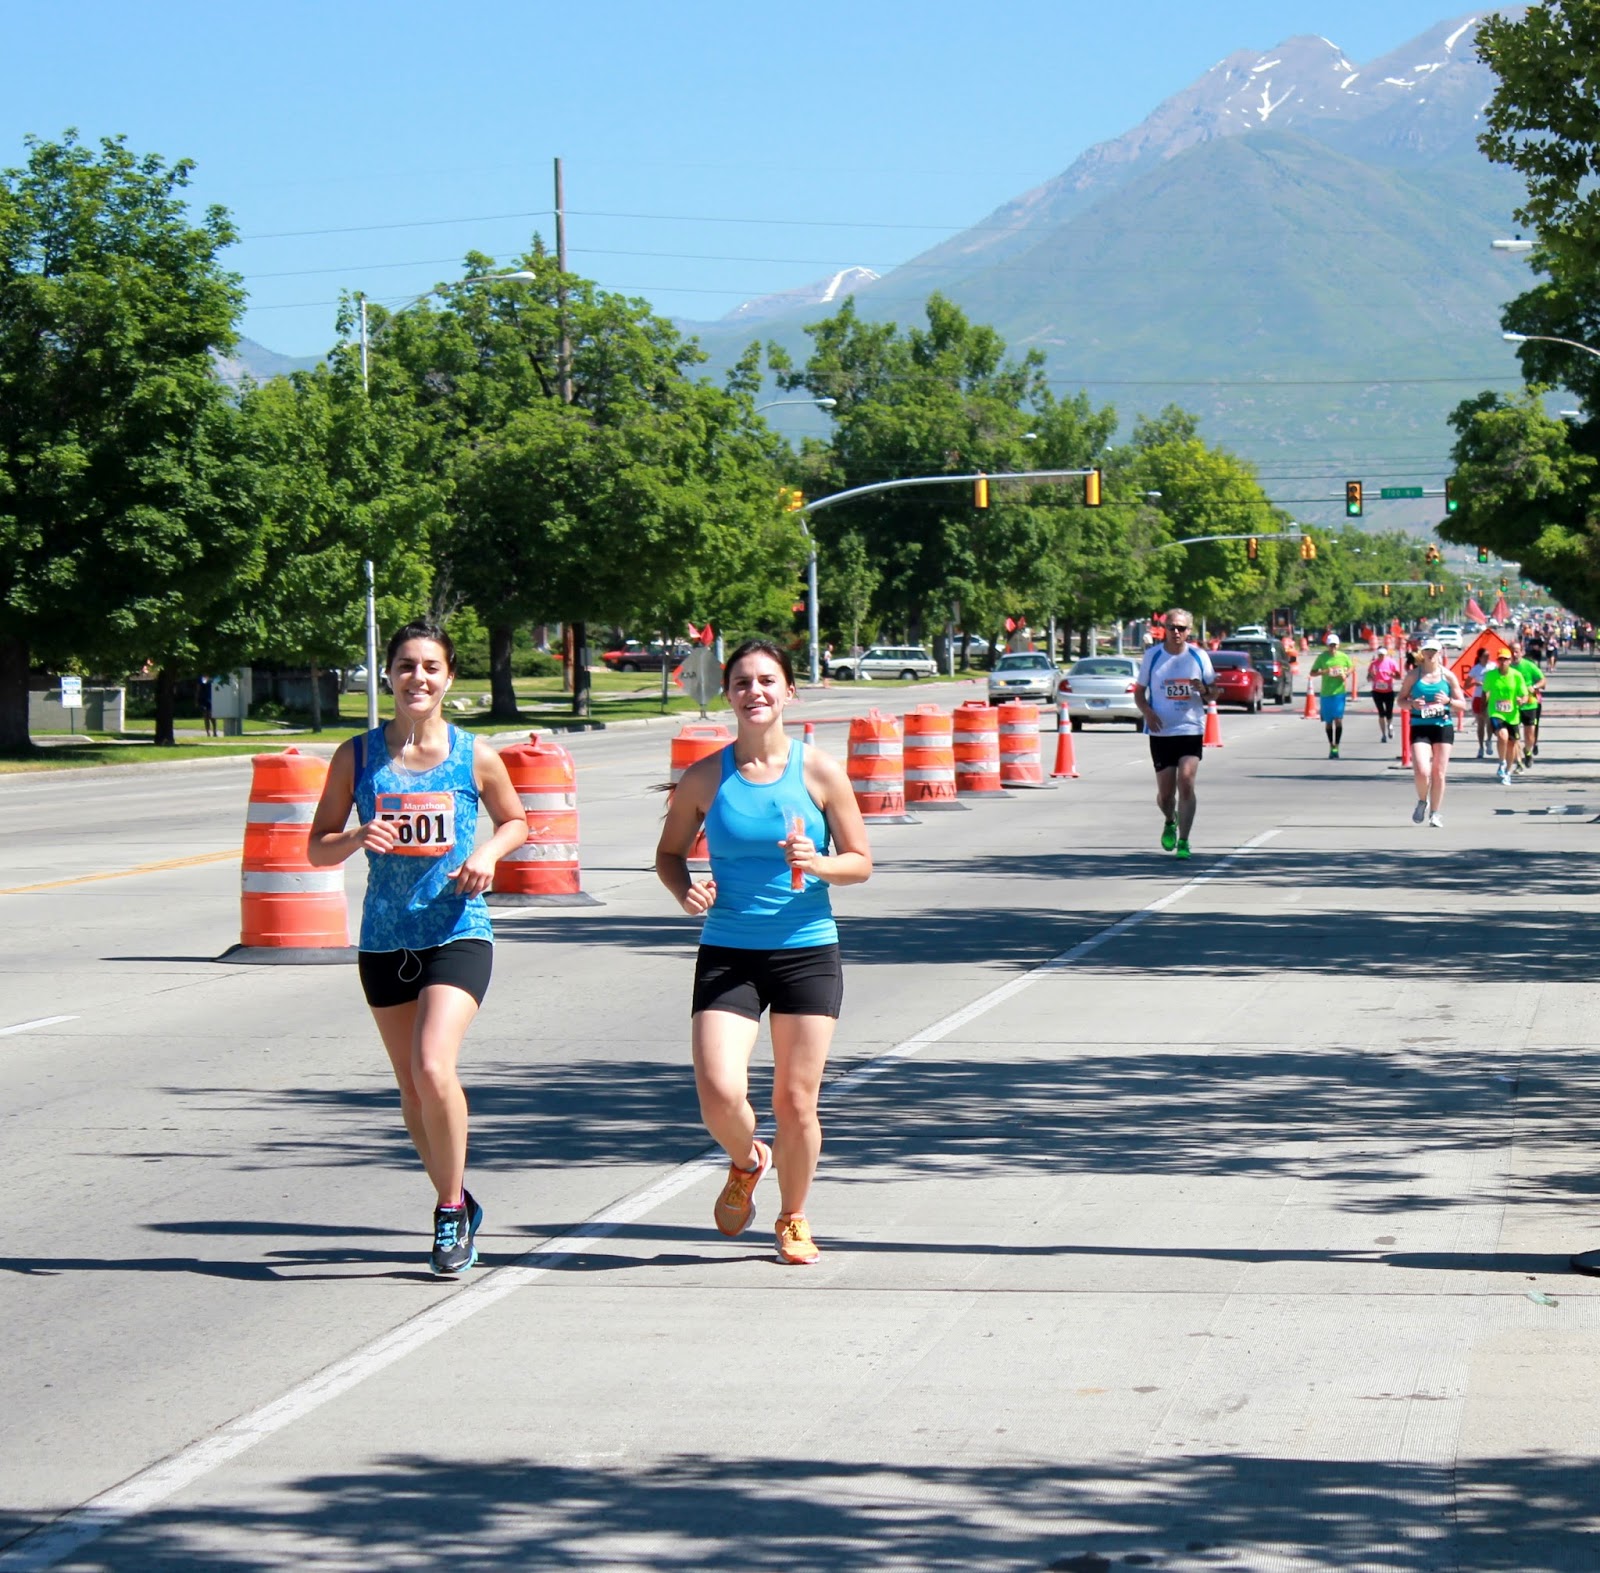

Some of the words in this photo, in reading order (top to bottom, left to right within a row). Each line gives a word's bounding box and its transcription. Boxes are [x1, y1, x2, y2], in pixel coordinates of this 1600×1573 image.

[1167, 685, 1190, 696] 6251
[403, 802, 447, 811] Marathon
[381, 813, 447, 844] 601
